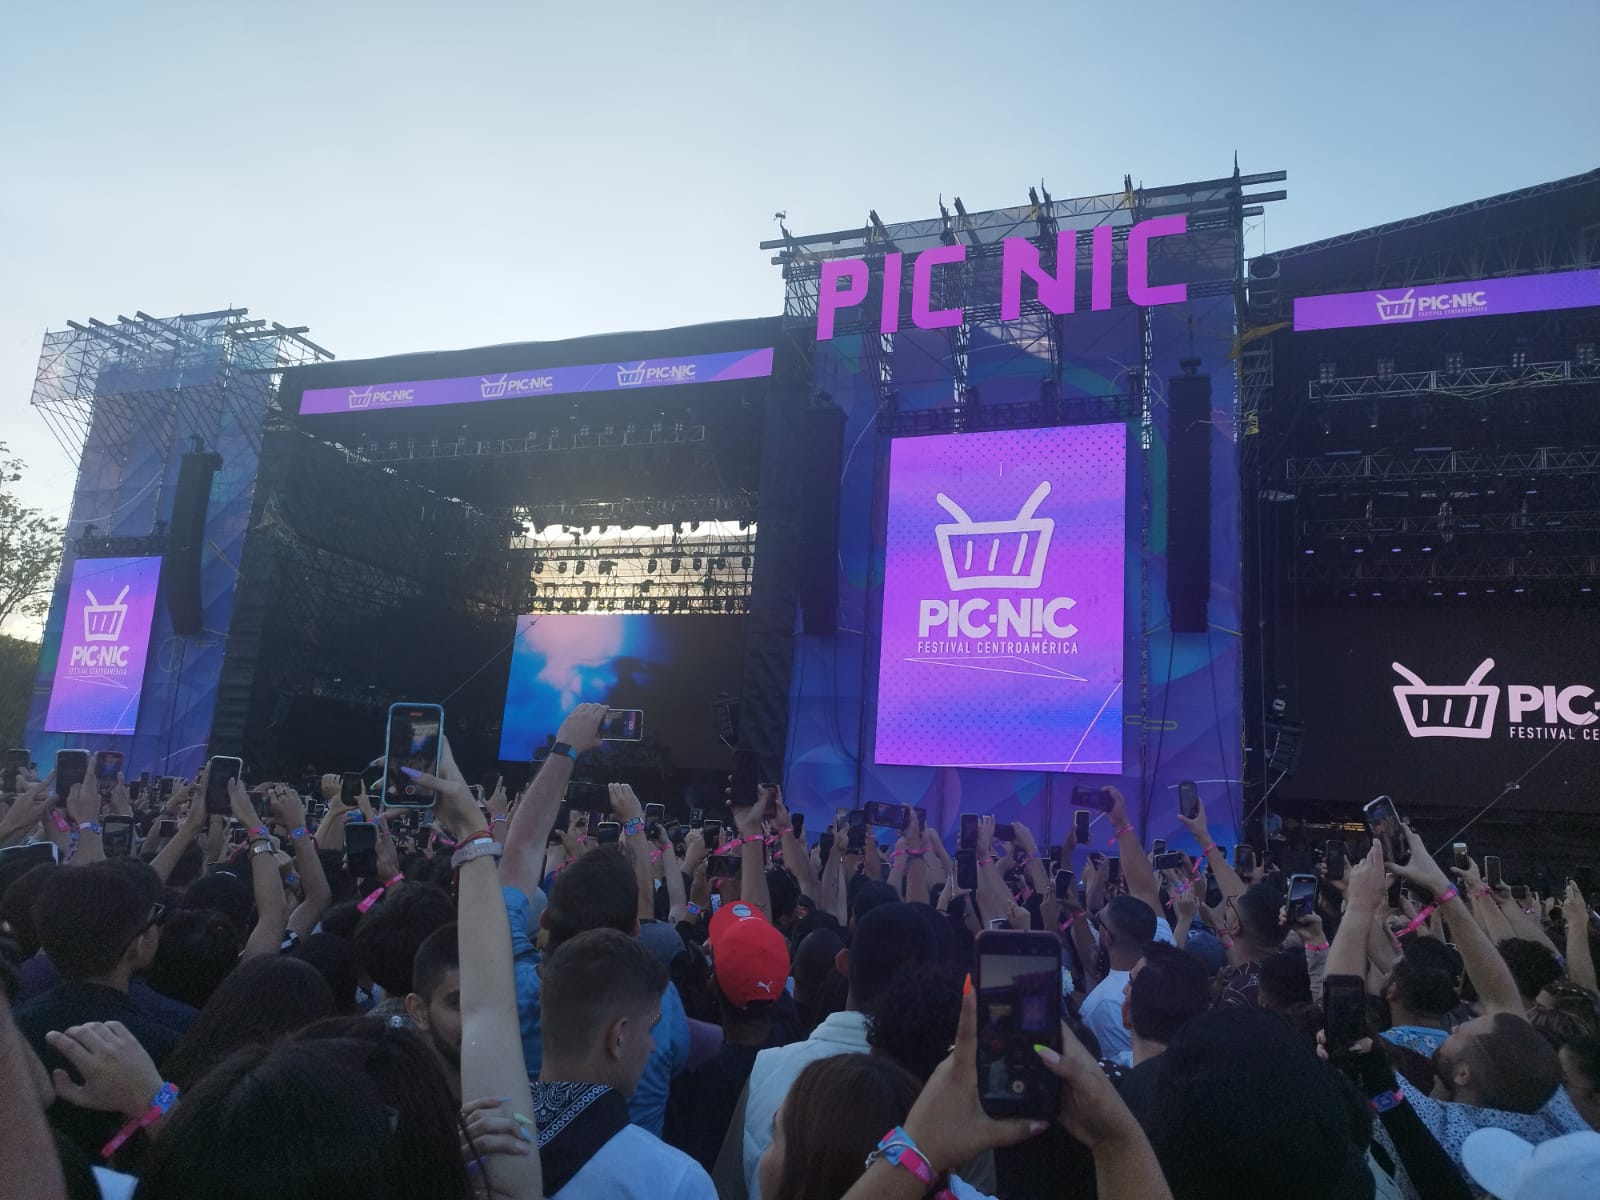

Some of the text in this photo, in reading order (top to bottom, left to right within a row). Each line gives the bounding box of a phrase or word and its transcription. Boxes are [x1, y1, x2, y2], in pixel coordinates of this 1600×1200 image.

[816, 215, 1188, 341] PIC NIC
[918, 639, 1079, 655] FESTIVAL CENTROAMÉRICA
[1509, 726, 1576, 740] FESTIVAL
